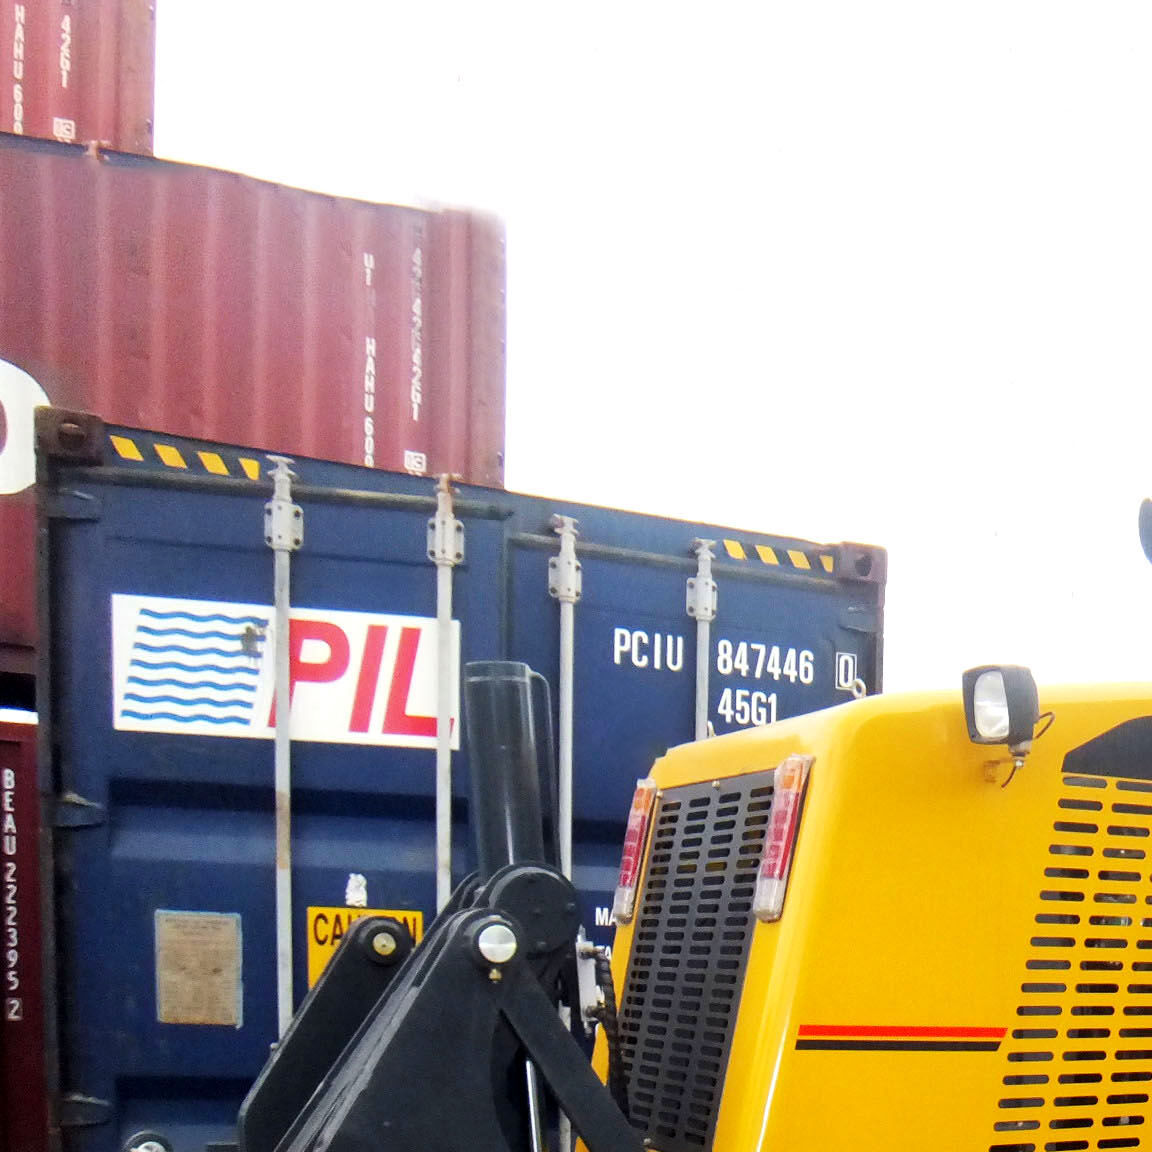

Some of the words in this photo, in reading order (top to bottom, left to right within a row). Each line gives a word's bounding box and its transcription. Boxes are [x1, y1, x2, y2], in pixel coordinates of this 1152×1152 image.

[267, 618, 455, 738] PIL
[613, 628, 684, 671] PCIU
[716, 639, 815, 685] 847446
[717, 687, 778, 726] 45G1
[2, 767, 17, 856] BEAU
[4, 861, 20, 992] 222395
